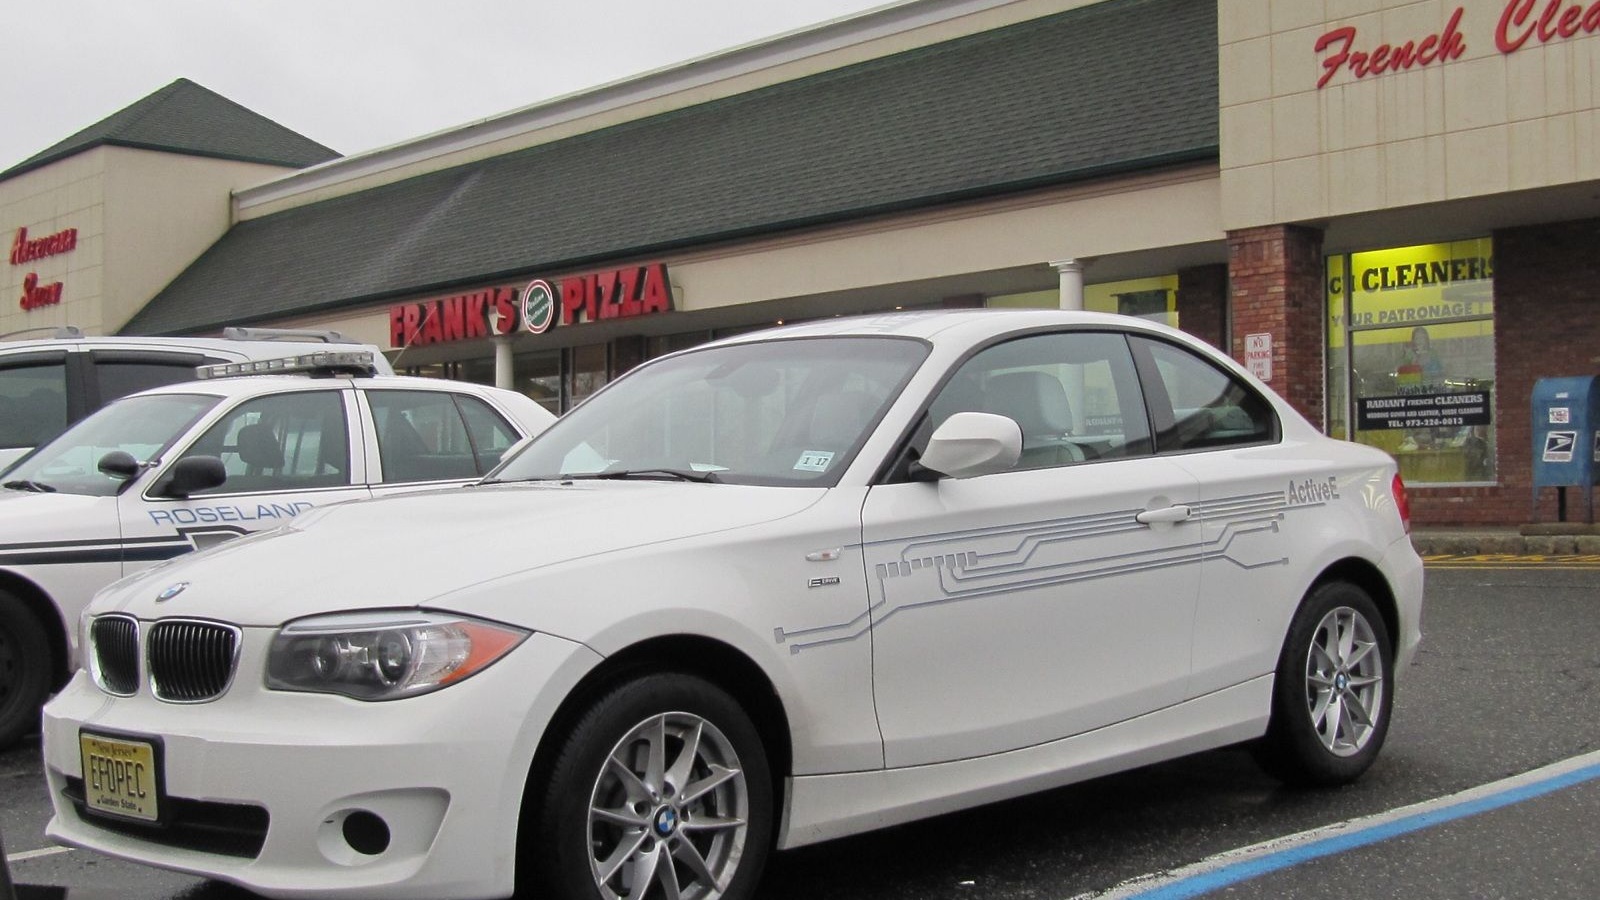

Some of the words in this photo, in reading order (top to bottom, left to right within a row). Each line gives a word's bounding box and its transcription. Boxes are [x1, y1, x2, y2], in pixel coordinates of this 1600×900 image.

[1314, 7, 1467, 90] French
[390, 287, 518, 348] FRANK'S
[562, 263, 673, 326] PIZZA
[1331, 311, 1374, 326] YUR
[1378, 302, 1474, 324] PATRONAGE
[1253, 339, 1264, 348] NO
[1366, 398, 1406, 409] RADIANT
[1407, 398, 1434, 406] FRENCH
[1435, 394, 1483, 405] CLEANERS
[803, 456, 810, 465] 1
[815, 457, 829, 466] 17
[1289, 476, 1340, 505] ActiveE
[148, 502, 314, 526] ROSELAND
